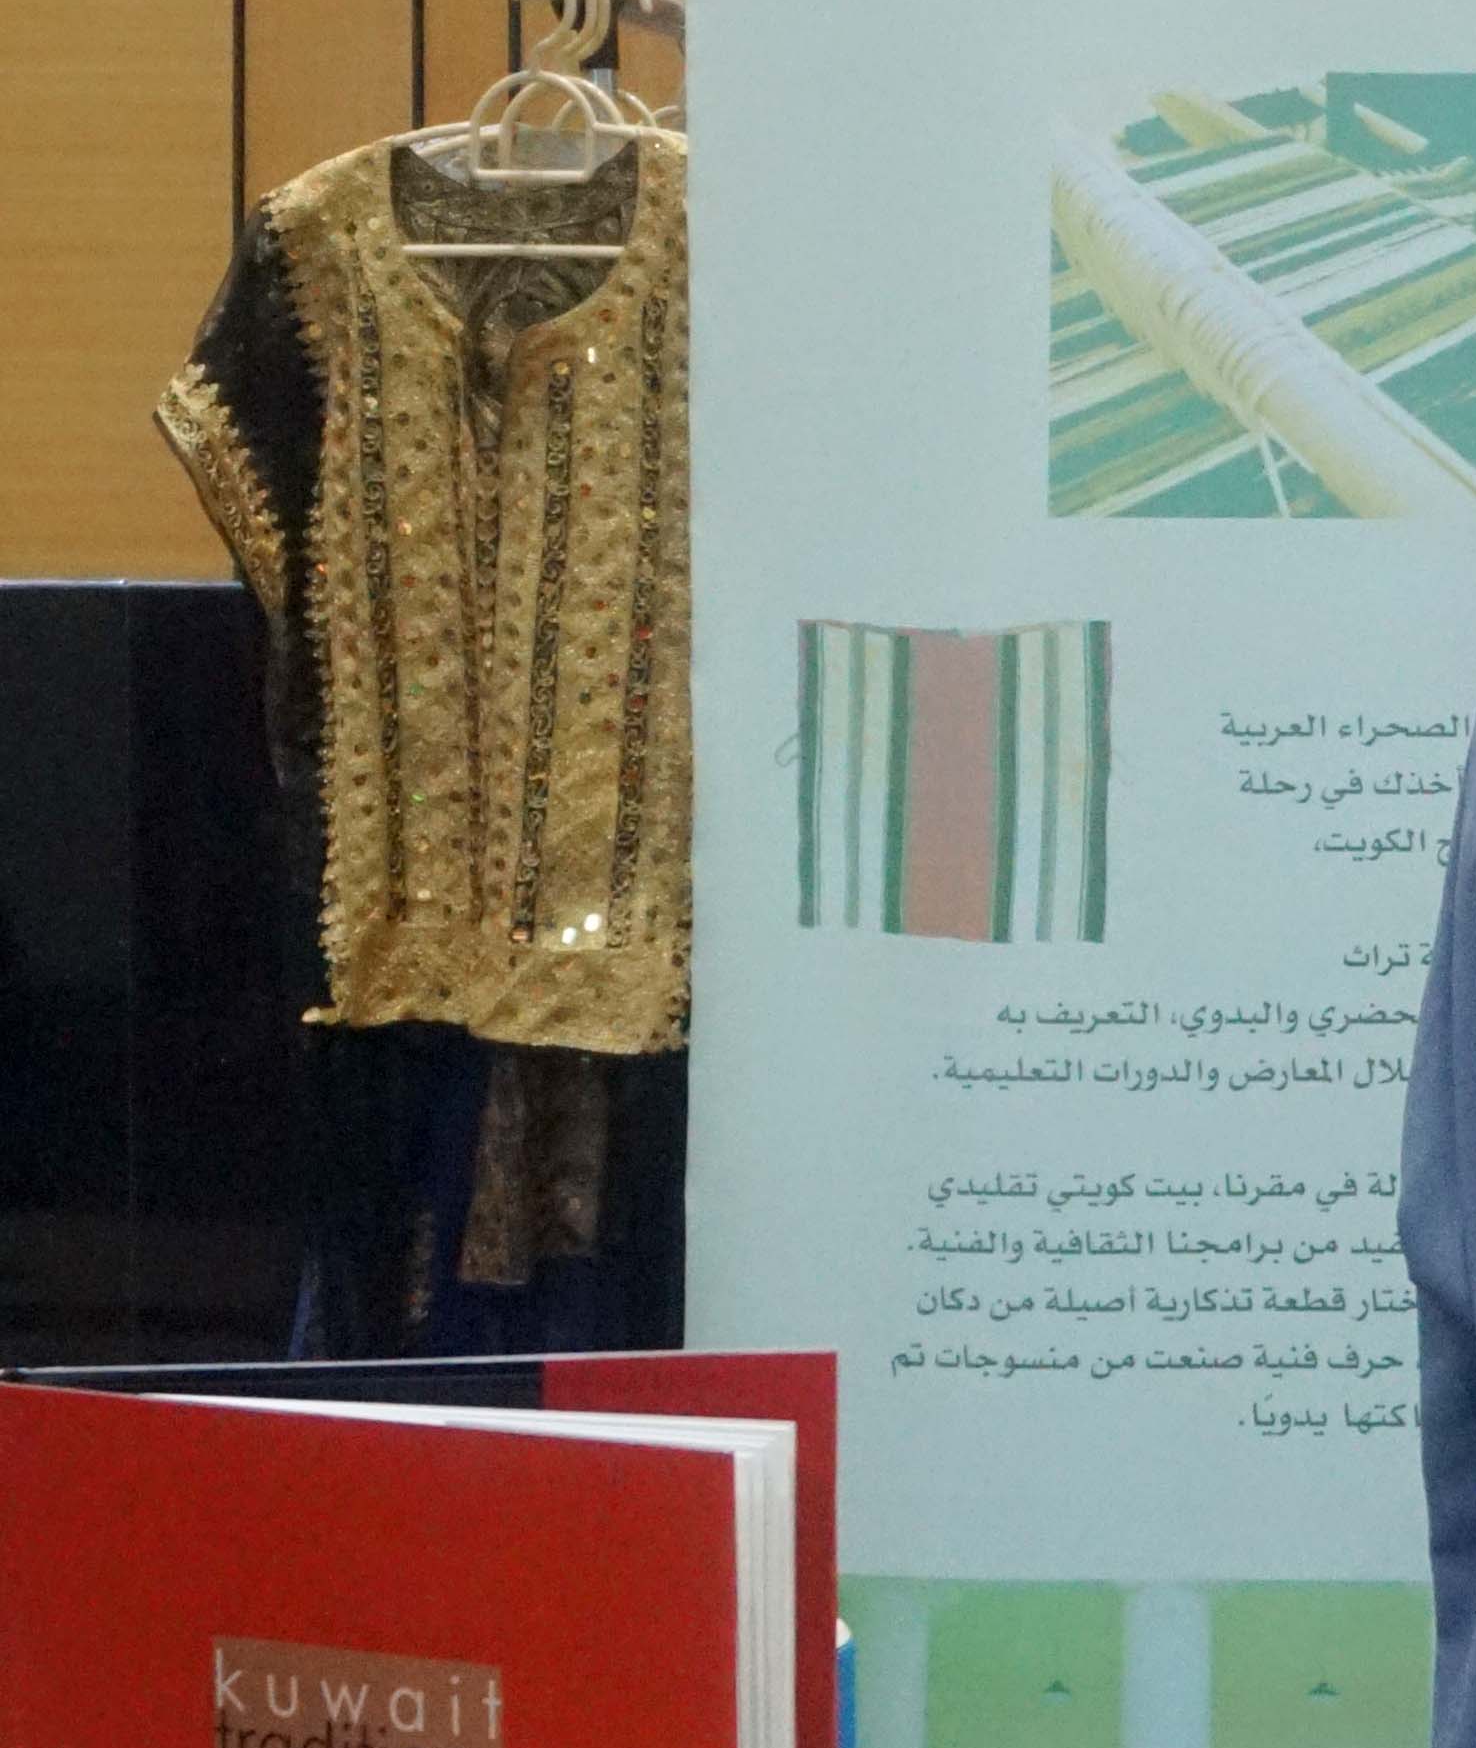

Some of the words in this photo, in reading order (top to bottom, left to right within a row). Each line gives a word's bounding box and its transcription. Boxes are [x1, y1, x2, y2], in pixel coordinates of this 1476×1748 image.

[1219, 711, 1326, 747] العربية
[1337, 714, 1470, 746] الصحراء
[1238, 769, 1312, 803] رحلة
[1320, 768, 1363, 809] في
[1343, 943, 1410, 976] تراث
[996, 1005, 1027, 1027] به
[1036, 1001, 1160, 1034] التعريف
[1093, 1057, 1220, 1093] والدورات
[1228, 1057, 1343, 1092] المعارض
[927, 1172, 1038, 1208] تقليدي
[1047, 1173, 1137, 1213] كويتي
[1144, 1177, 1204, 1207] بيت
[1315, 1171, 1357, 1212] في
[1032, 1229, 1155, 1264] الثقافية
[1167, 1230, 1284, 1264] برامجنا
[1292, 1238, 1338, 1264] من
[916, 1286, 981, 1317] دكان
[989, 1296, 1035, 1322] من
[1044, 1284, 1136, 1322] أصيلة
[1144, 1287, 1254, 1323] تذكارية
[1262, 1286, 1346, 1313] قطعة
[891, 1342, 926, 1378] تم
[934, 1344, 1081, 1379] منسوجات
[1090, 1353, 1136, 1380] من
[1145, 1346, 1244, 1370] صنعت
[1253, 1342, 1319, 1379] فنية
[1327, 1344, 1404, 1379] حرف
[213, 1647, 503, 1741] kuwait
